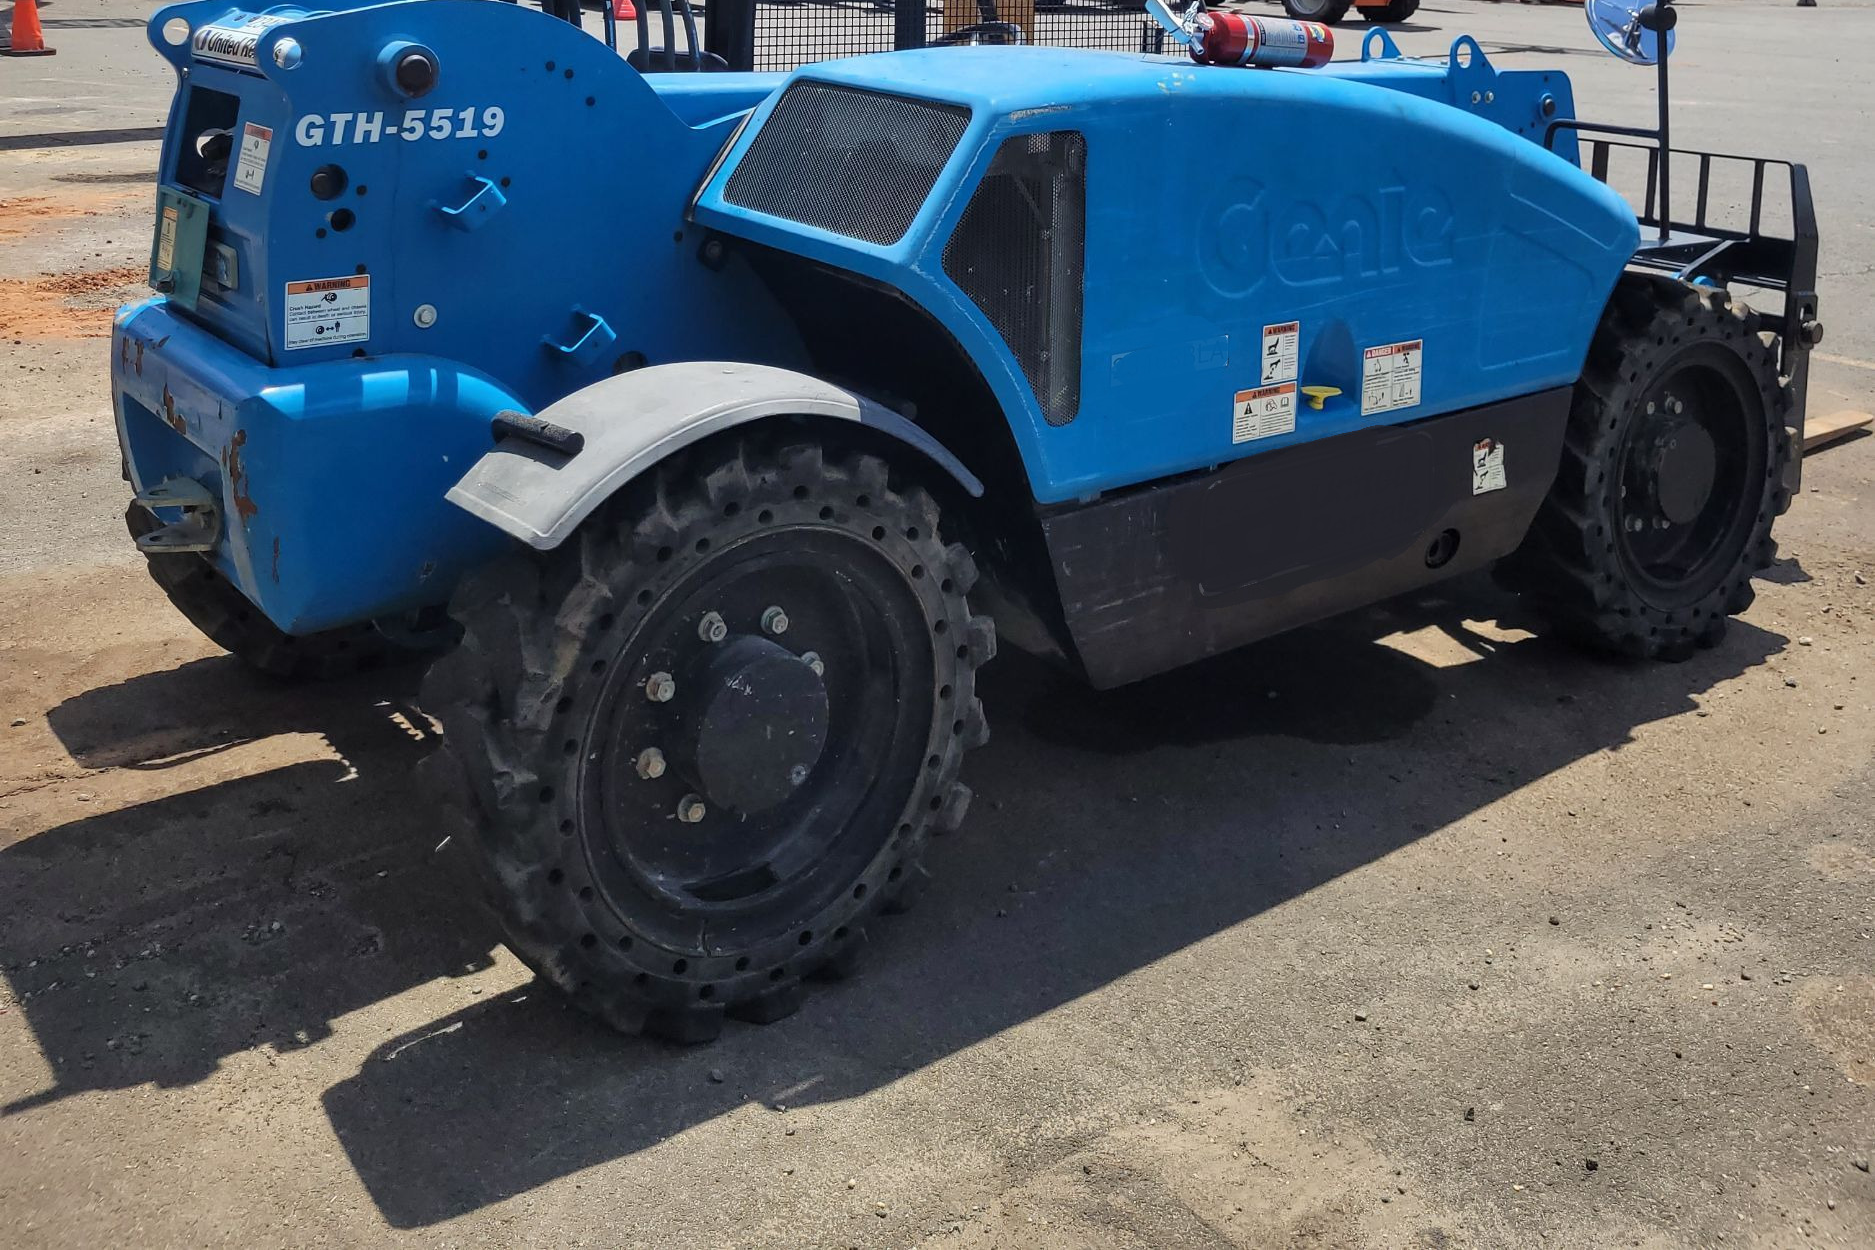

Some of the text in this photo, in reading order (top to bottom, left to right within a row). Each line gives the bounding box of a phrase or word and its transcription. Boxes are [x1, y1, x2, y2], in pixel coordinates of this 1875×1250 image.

[208, 31, 242, 56] United
[295, 106, 505, 147] GTH-5519
[1196, 176, 1454, 296] Genie
[314, 279, 351, 290] WARNING
